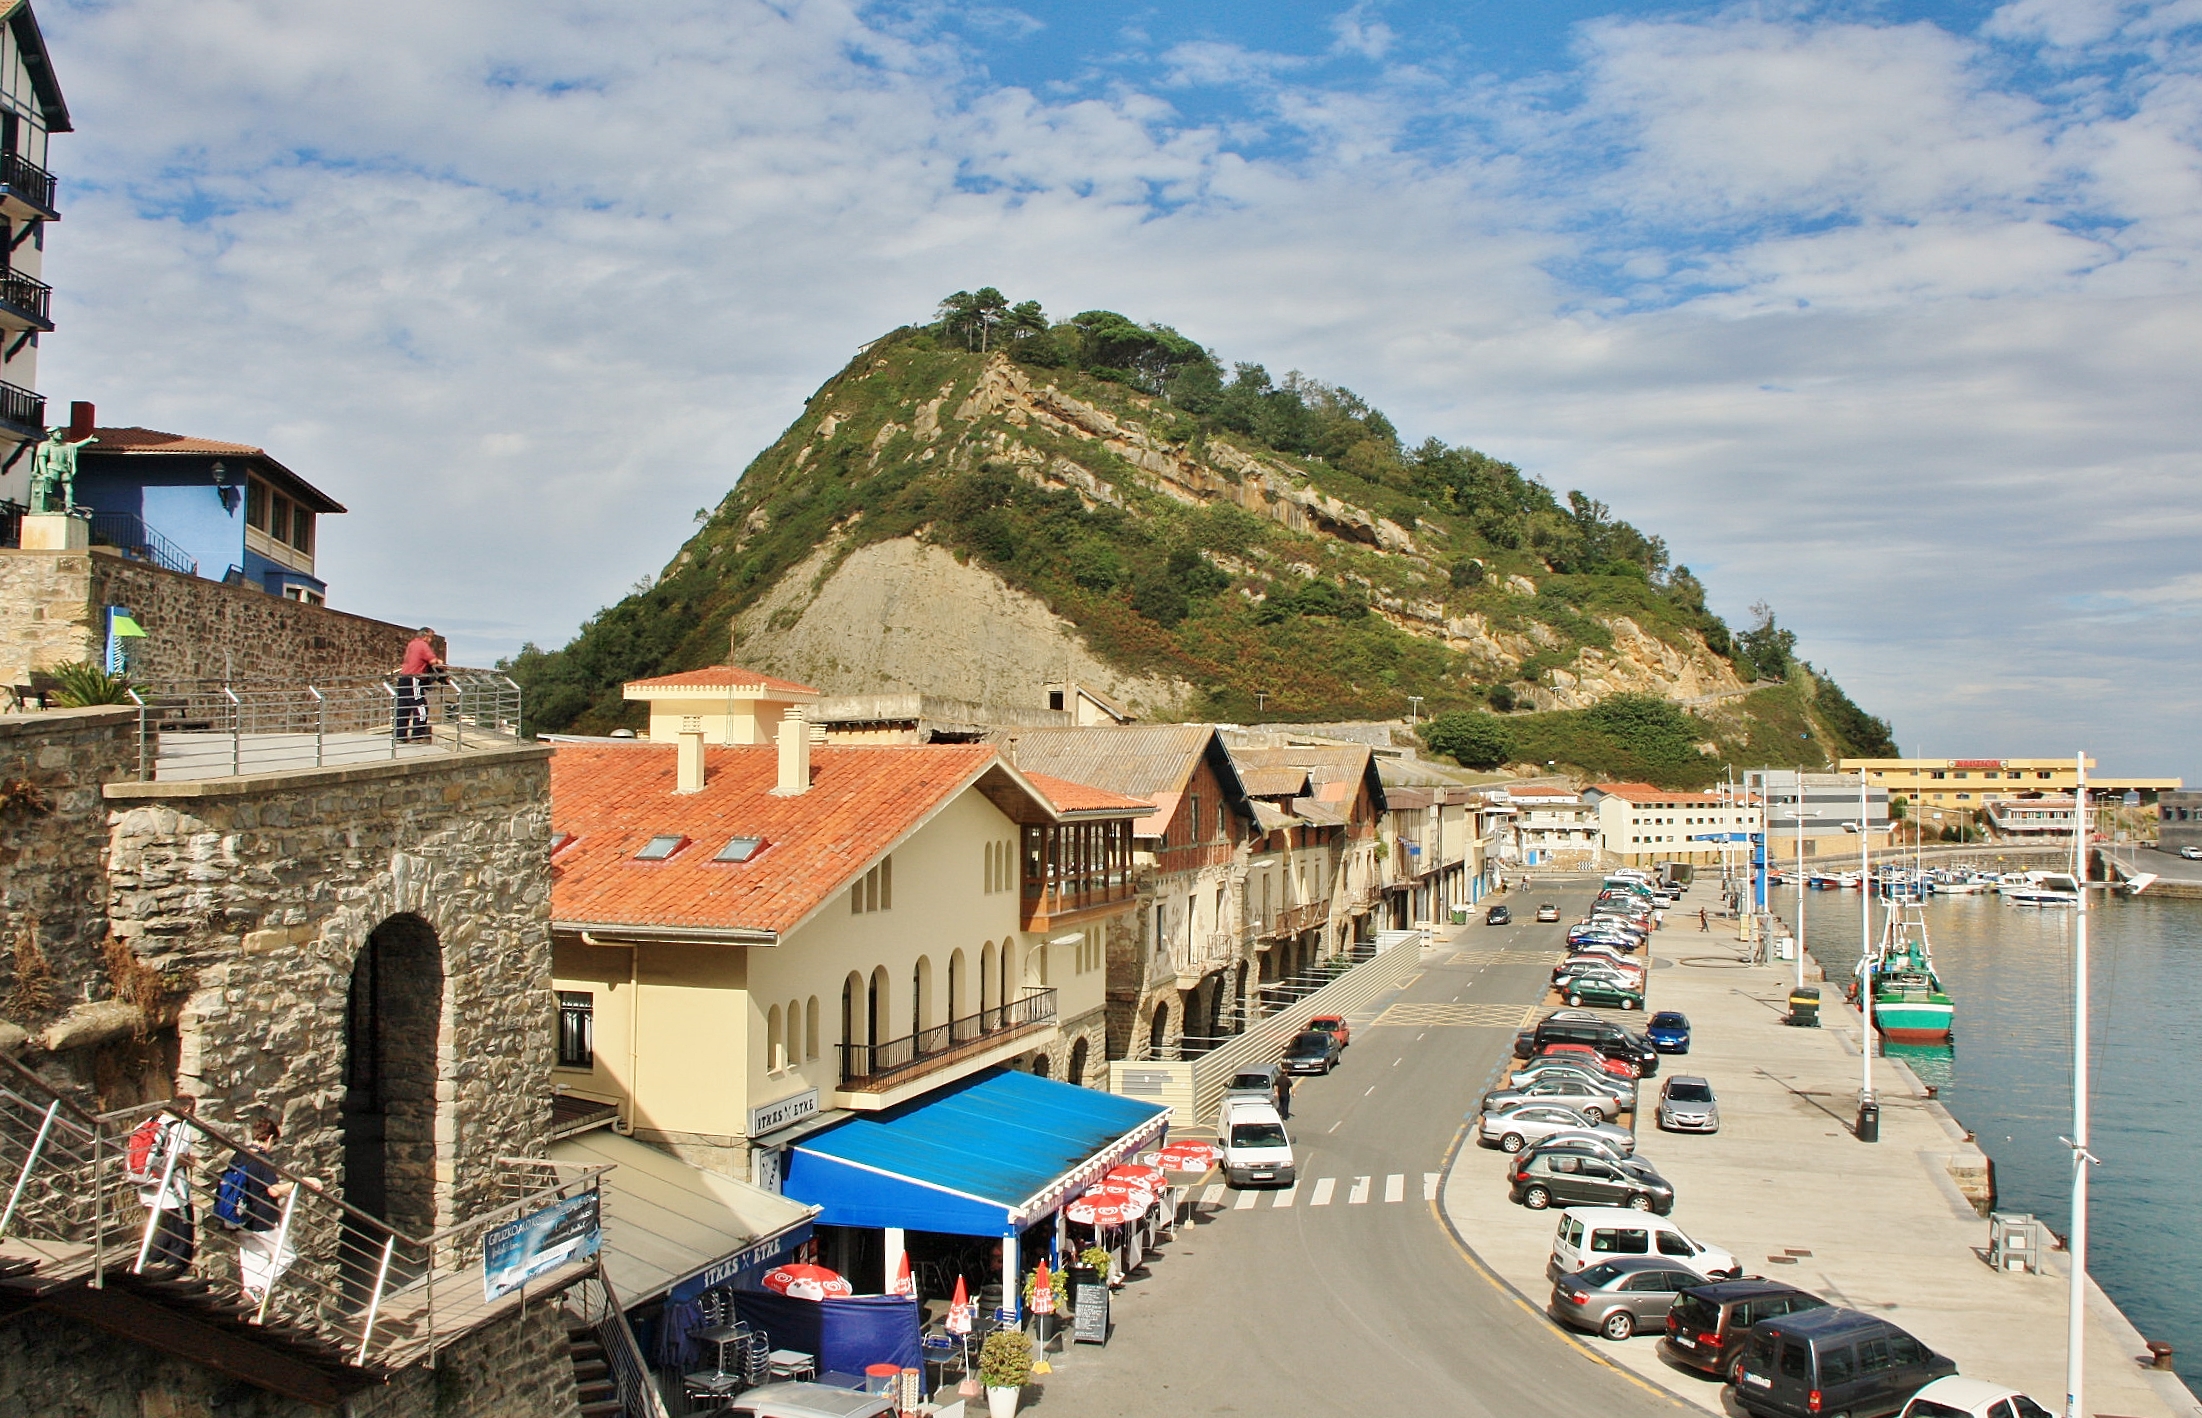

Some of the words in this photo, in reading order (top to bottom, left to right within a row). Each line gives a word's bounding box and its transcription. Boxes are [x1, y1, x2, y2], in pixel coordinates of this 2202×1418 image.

[758, 1110, 783, 1130] ITXAS
[794, 1099, 814, 1116] ETXE
[704, 1258, 739, 1288] ITXAS
[754, 1238, 780, 1264] ETXE
